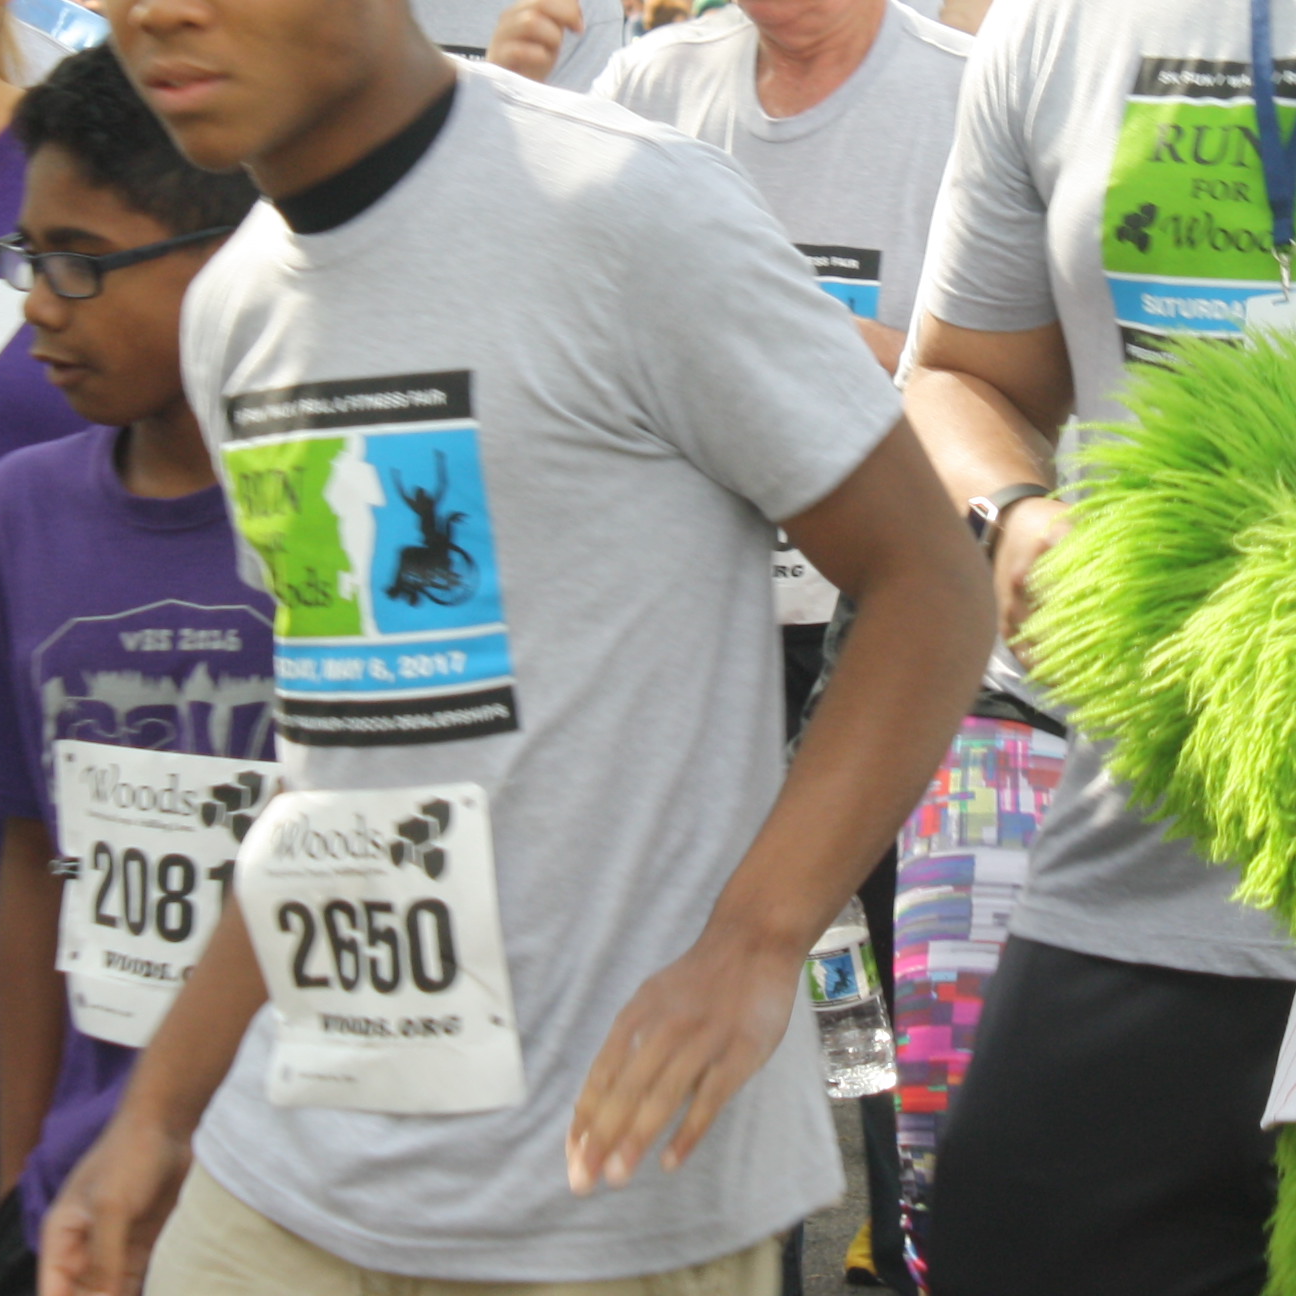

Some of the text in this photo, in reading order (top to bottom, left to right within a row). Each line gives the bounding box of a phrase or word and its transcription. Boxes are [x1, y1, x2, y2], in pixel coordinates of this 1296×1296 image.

[1190, 178, 1252, 203] FOR
[396, 649, 468, 680] 2017
[79, 763, 200, 816] Woods
[276, 897, 458, 993] 2650
